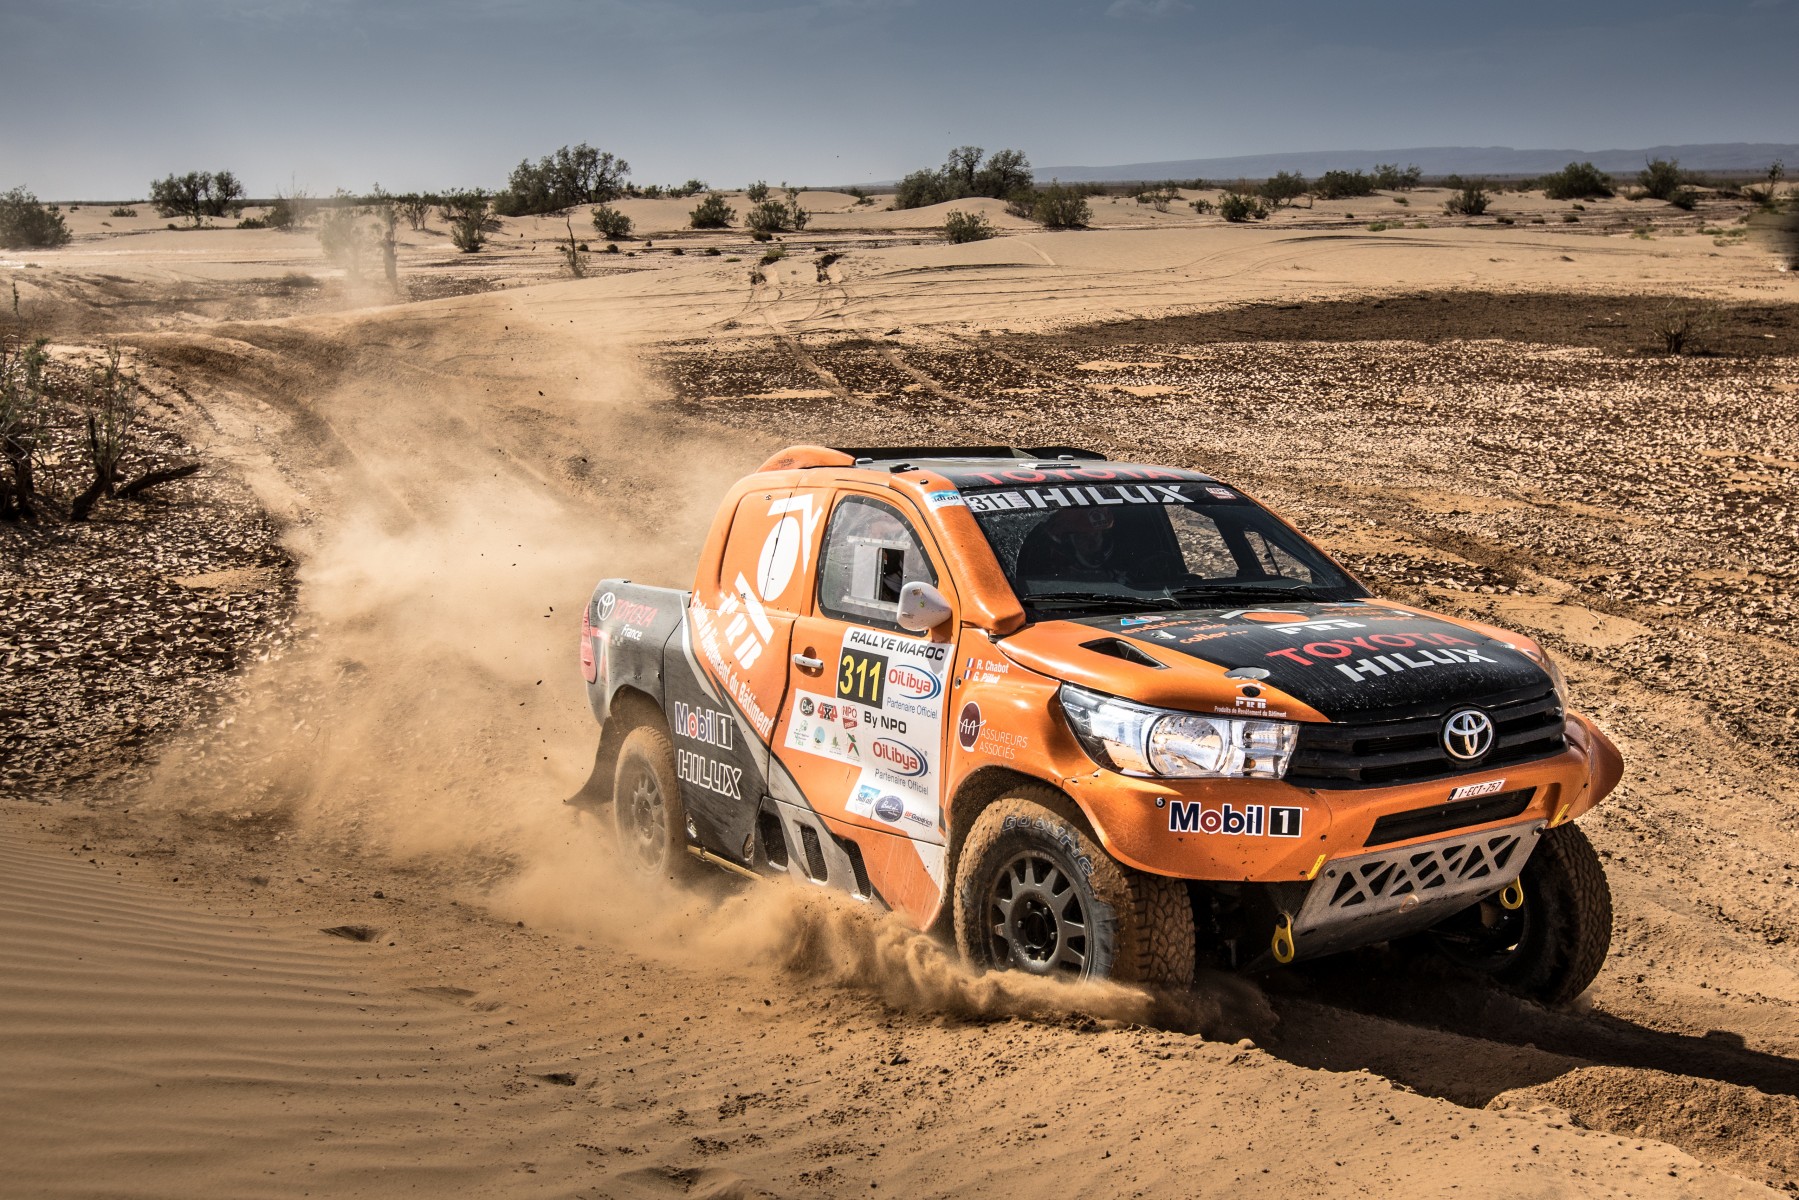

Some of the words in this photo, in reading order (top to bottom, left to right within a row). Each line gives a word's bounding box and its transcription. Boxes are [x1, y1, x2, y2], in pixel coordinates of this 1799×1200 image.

[961, 469, 1184, 485] TOYOTA
[968, 494, 1014, 511] 311
[1023, 485, 1195, 508] HILUX
[613, 598, 659, 628] TOYOTA
[620, 623, 643, 641] France
[1276, 619, 1368, 635] PRB
[850, 631, 896, 652] RALLYE
[896, 640, 945, 661] MAROC
[1265, 632, 1479, 667] TOYOTA
[972, 671, 980, 682] G.
[976, 659, 984, 670] R.
[985, 660, 1010, 674] Chabot
[1334, 647, 1498, 683] HILUX
[839, 654, 882, 702] 311
[729, 671, 739, 697] du
[737, 682, 776, 738] Bâtiment
[842, 706, 858, 719] NPO
[886, 696, 916, 714] Partenaire
[916, 704, 939, 720] Officiel
[1235, 701, 1267, 709] PRB
[674, 700, 716, 745] Mobil
[864, 710, 878, 729] By
[880, 715, 907, 735] NPO
[980, 728, 1029, 749] ASSUREURS
[979, 741, 1016, 760] ASSOCIÉS
[677, 748, 743, 801] HILUX
[874, 768, 907, 787] Partenaire
[907, 779, 930, 796] Officiel
[1458, 781, 1502, 798] 1-ECT-757
[1168, 800, 1265, 837] Mobil
